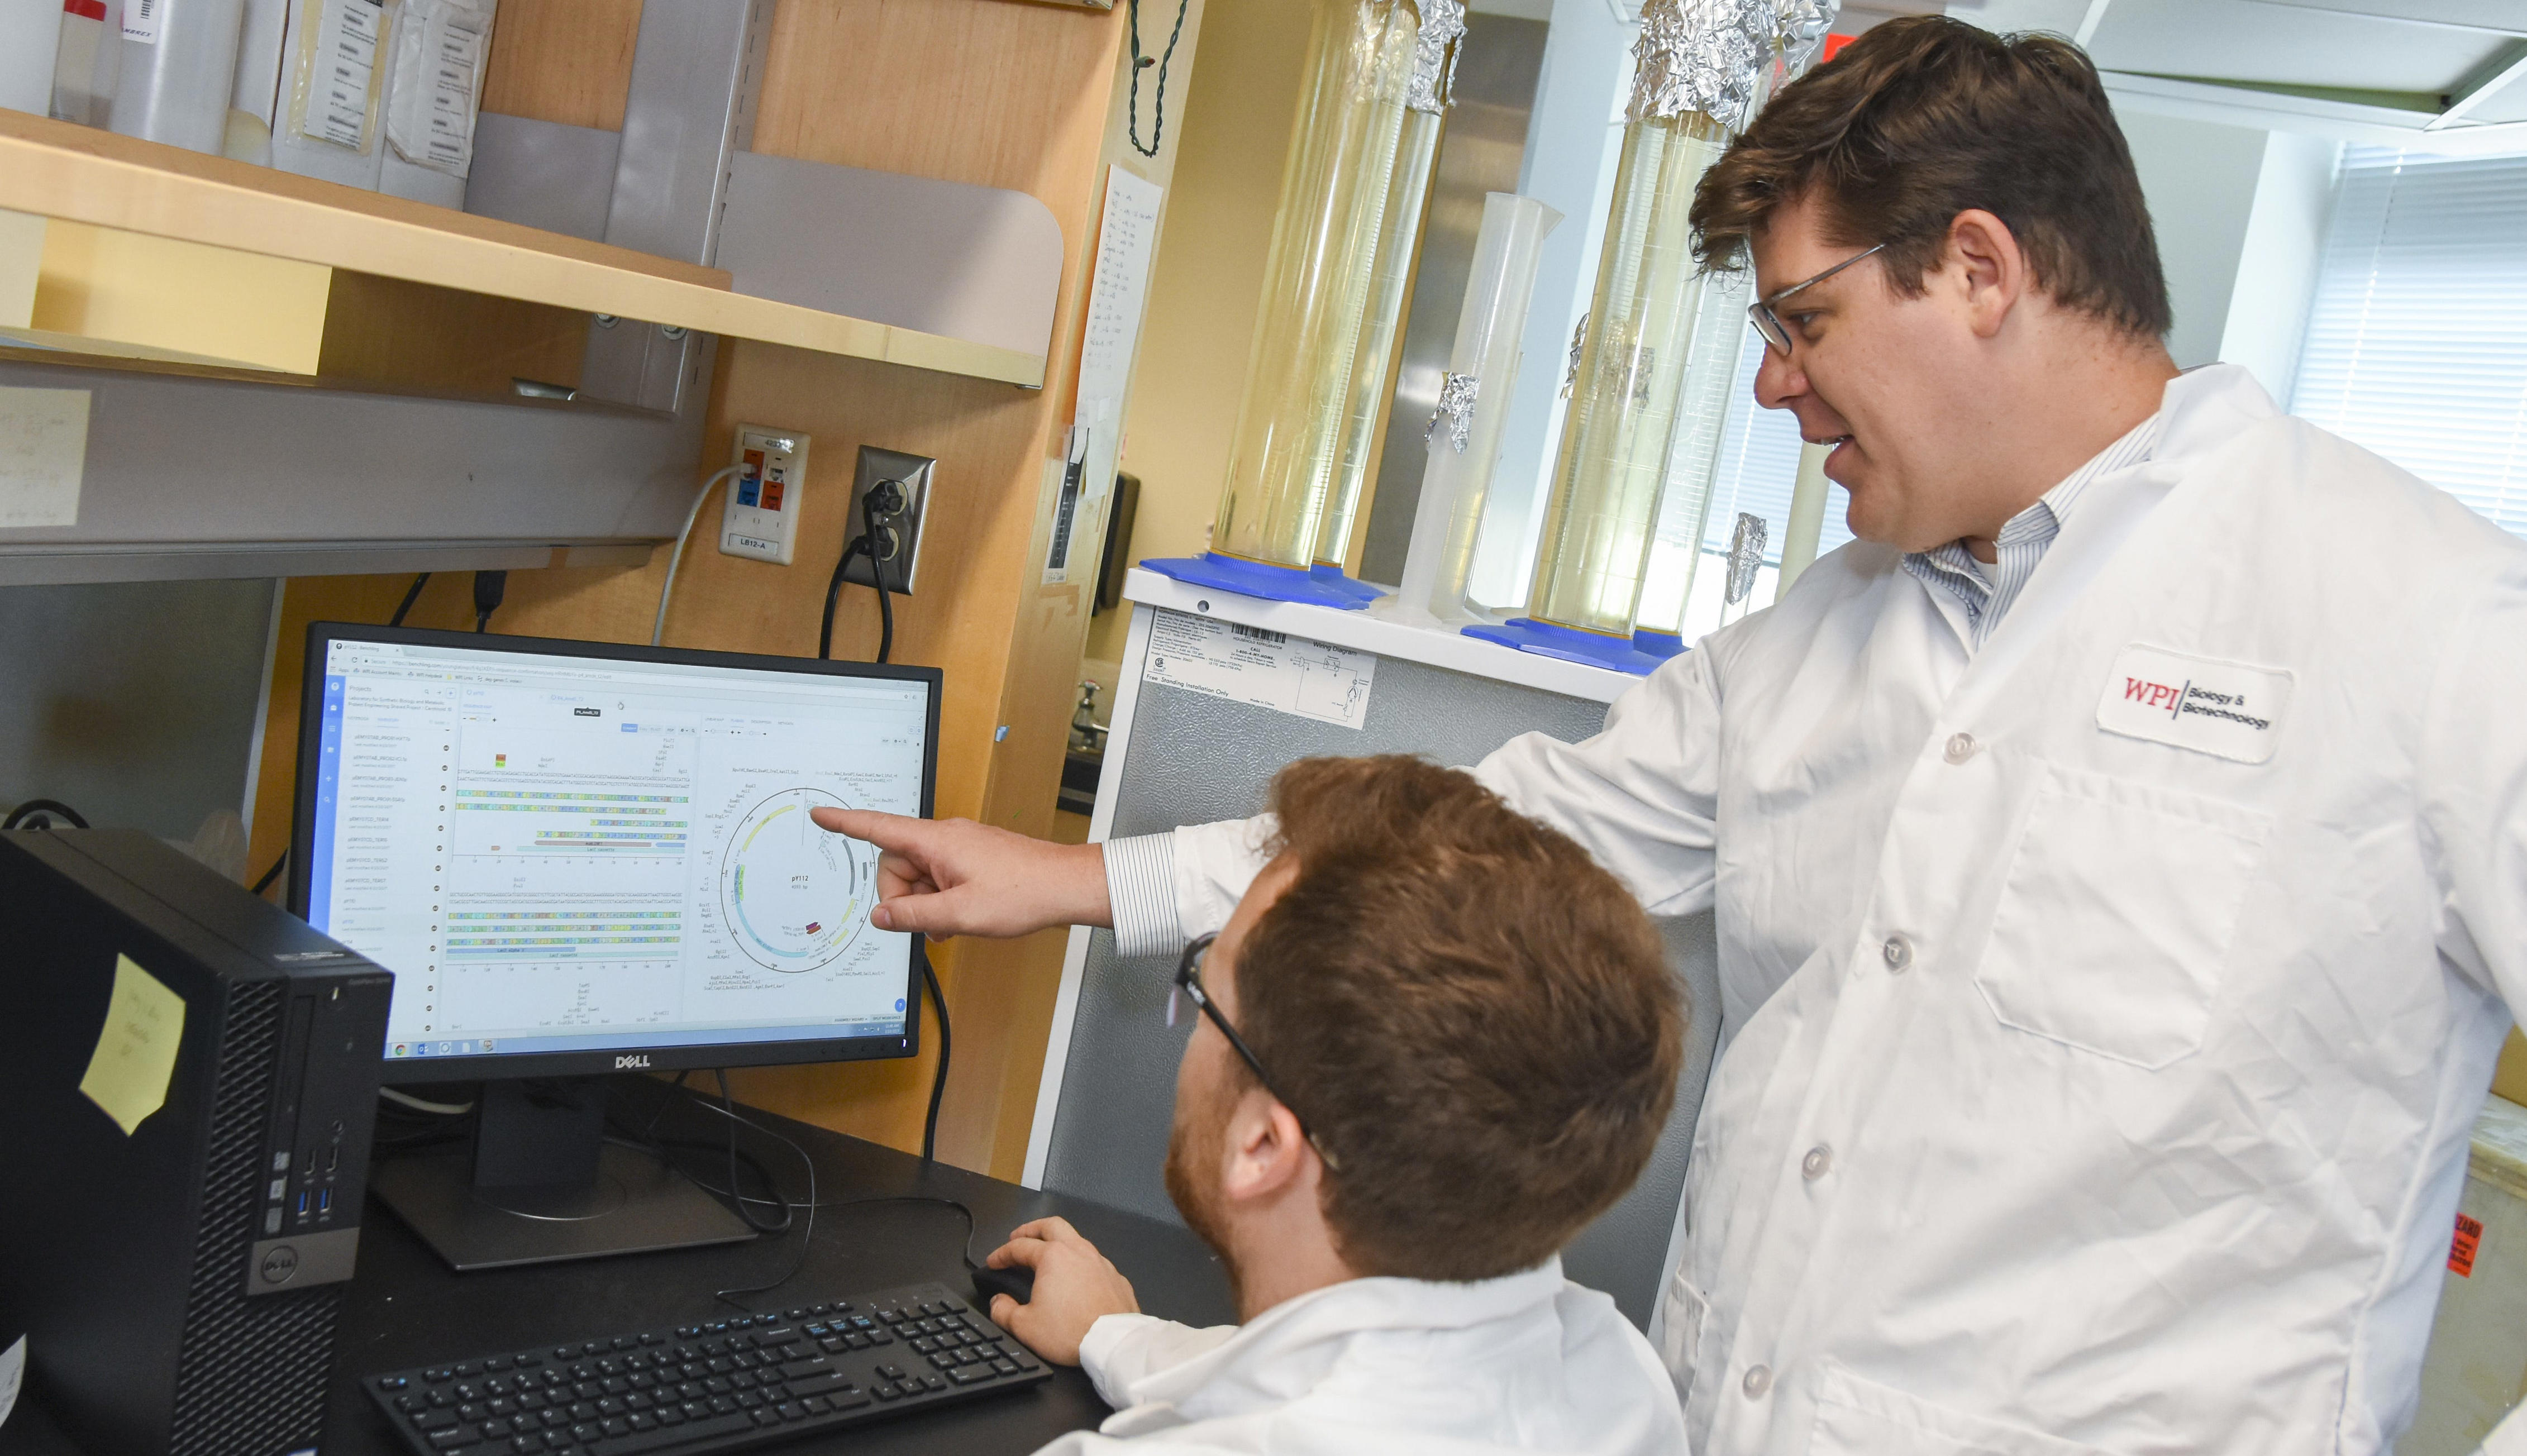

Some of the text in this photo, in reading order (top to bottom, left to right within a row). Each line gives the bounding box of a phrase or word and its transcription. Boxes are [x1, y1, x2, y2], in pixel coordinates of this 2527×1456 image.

[740, 539, 766, 550] LB12-A
[1313, 641, 1357, 656] Wiring Diagram
[1161, 677, 1184, 688] Standing
[1186, 682, 1214, 694] Installation
[1215, 689, 1229, 697] Only
[2124, 677, 2180, 710] WPI
[2188, 688, 2245, 706] Biology &
[2182, 702, 2271, 730] Biotechnology
[616, 1055, 650, 1069] DELL
[265, 1259, 293, 1271] DELL
